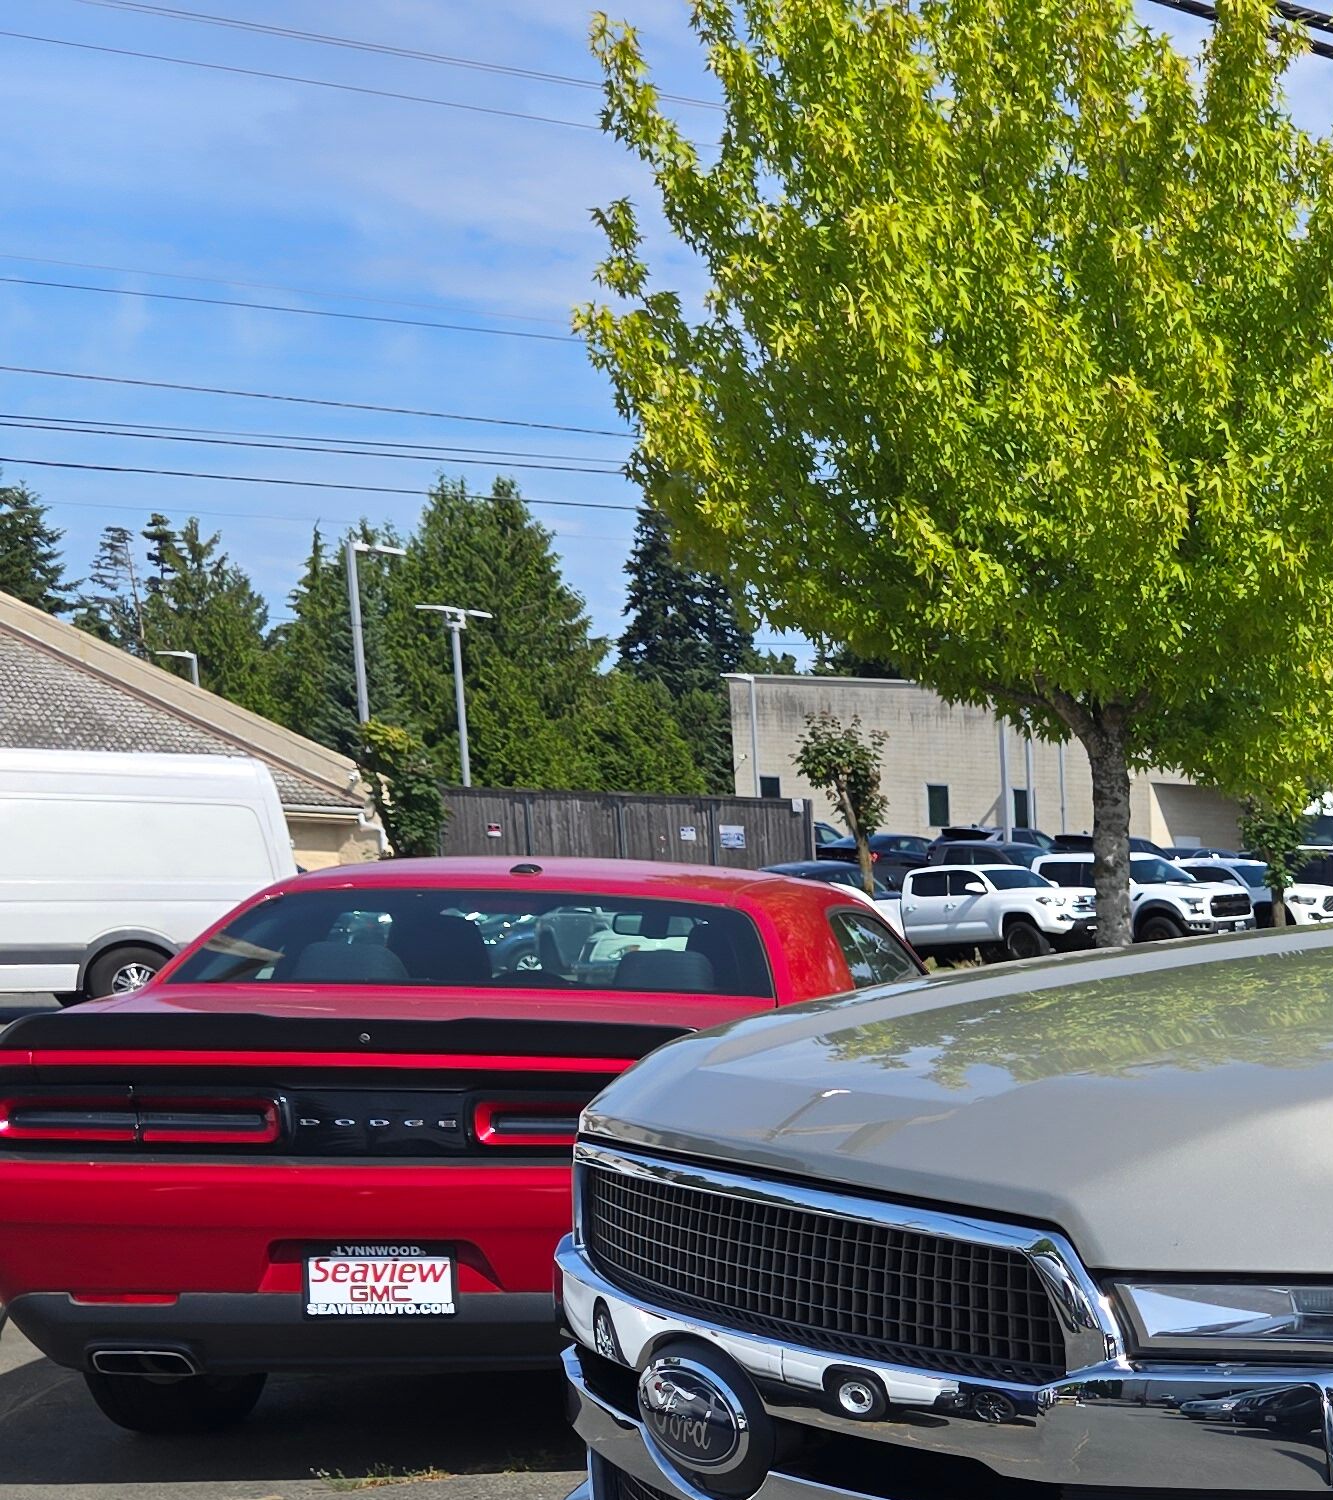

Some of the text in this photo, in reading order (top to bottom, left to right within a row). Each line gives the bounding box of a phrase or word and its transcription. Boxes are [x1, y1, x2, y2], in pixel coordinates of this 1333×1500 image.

[300, 1118, 457, 1128] DODGE
[336, 1246, 421, 1256] LYNNWOOD
[311, 1258, 448, 1283] Seaview
[350, 1285, 412, 1302] GMC
[307, 1303, 455, 1315] SEAVIEWAUTO.COM
